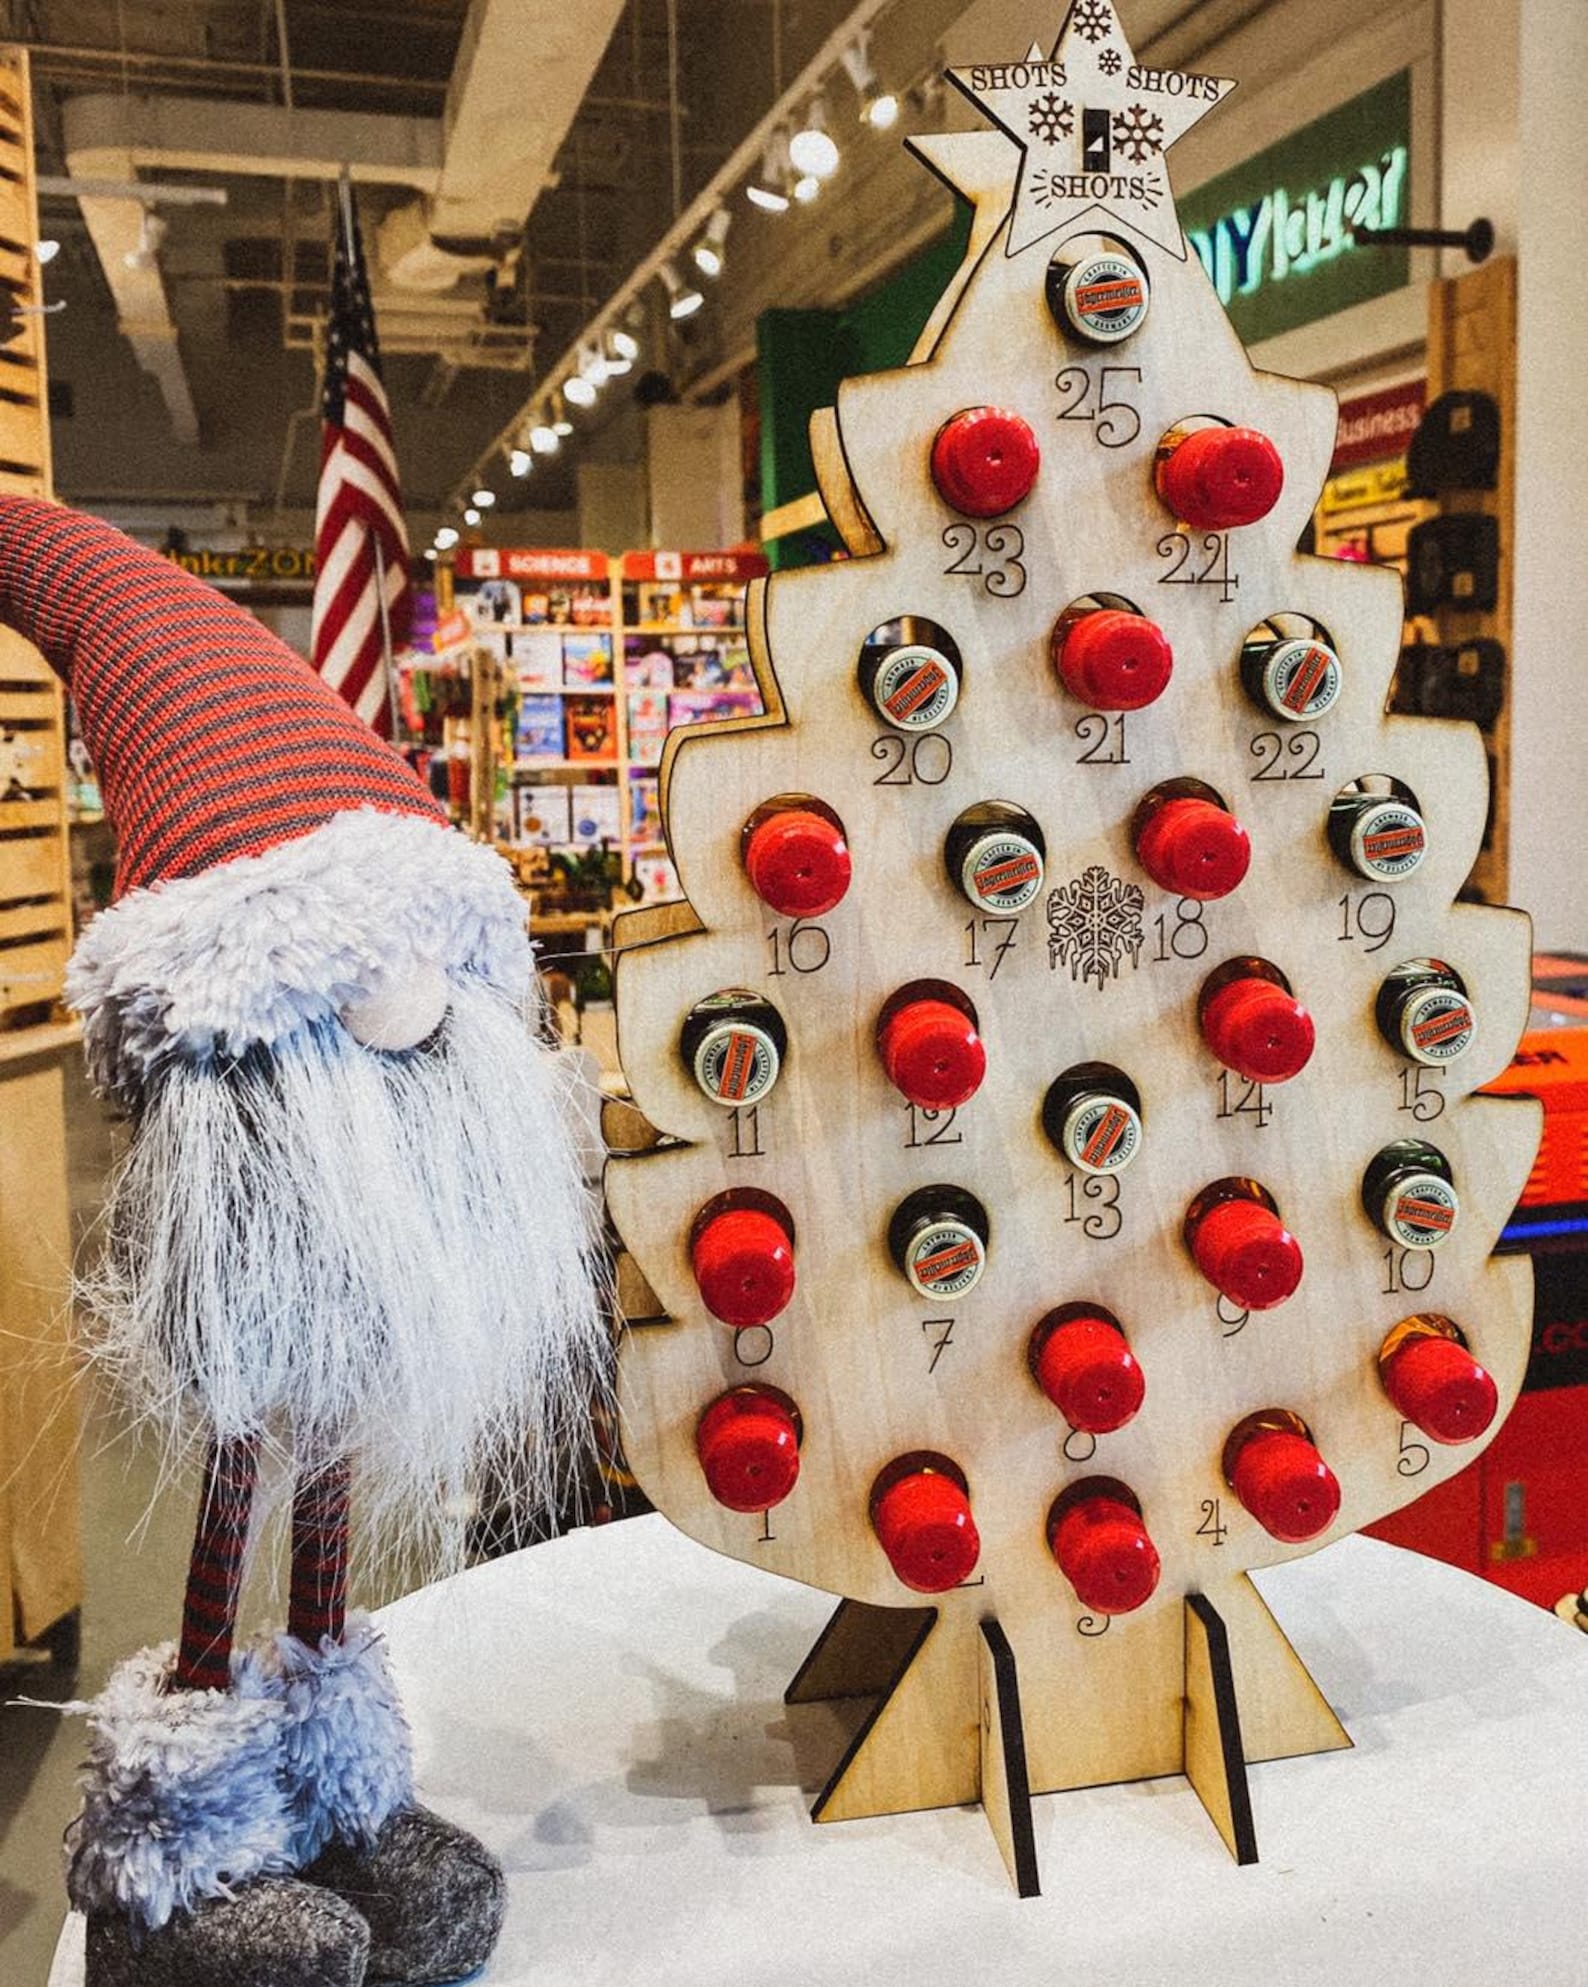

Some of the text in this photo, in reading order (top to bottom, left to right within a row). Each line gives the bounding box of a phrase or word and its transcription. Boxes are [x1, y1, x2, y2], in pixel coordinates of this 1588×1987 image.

[971, 63, 1067, 91] SHOTS
[1126, 66, 1219, 100] SHOTS
[1051, 175, 1146, 199] SHOTS
[1054, 366, 1142, 448] 25
[1337, 404, 1420, 447] usiness
[509, 555, 590, 574] SCIENCE
[690, 557, 737, 574] ARTS
[942, 523, 1027, 598] 23
[1156, 533, 1239, 602] 24
[871, 733, 952, 785] 20
[1074, 713, 1131, 764] 21
[1249, 731, 1325, 781] 22
[964, 918, 1019, 979] 17
[1152, 897, 1208, 961] 18
[1338, 893, 1396, 953] 19
[1216, 1071, 1273, 1128] 14
[1397, 1067, 1446, 1121] 15
[728, 1106, 765, 1157] 11
[904, 1102, 962, 1148] 12
[1063, 1174, 1122, 1239] 13
[1382, 1249, 1434, 1293] 10
[922, 1319, 955, 1373] 7
[1397, 1421, 1430, 1476] 5
[1196, 1499, 1227, 1545] 4
